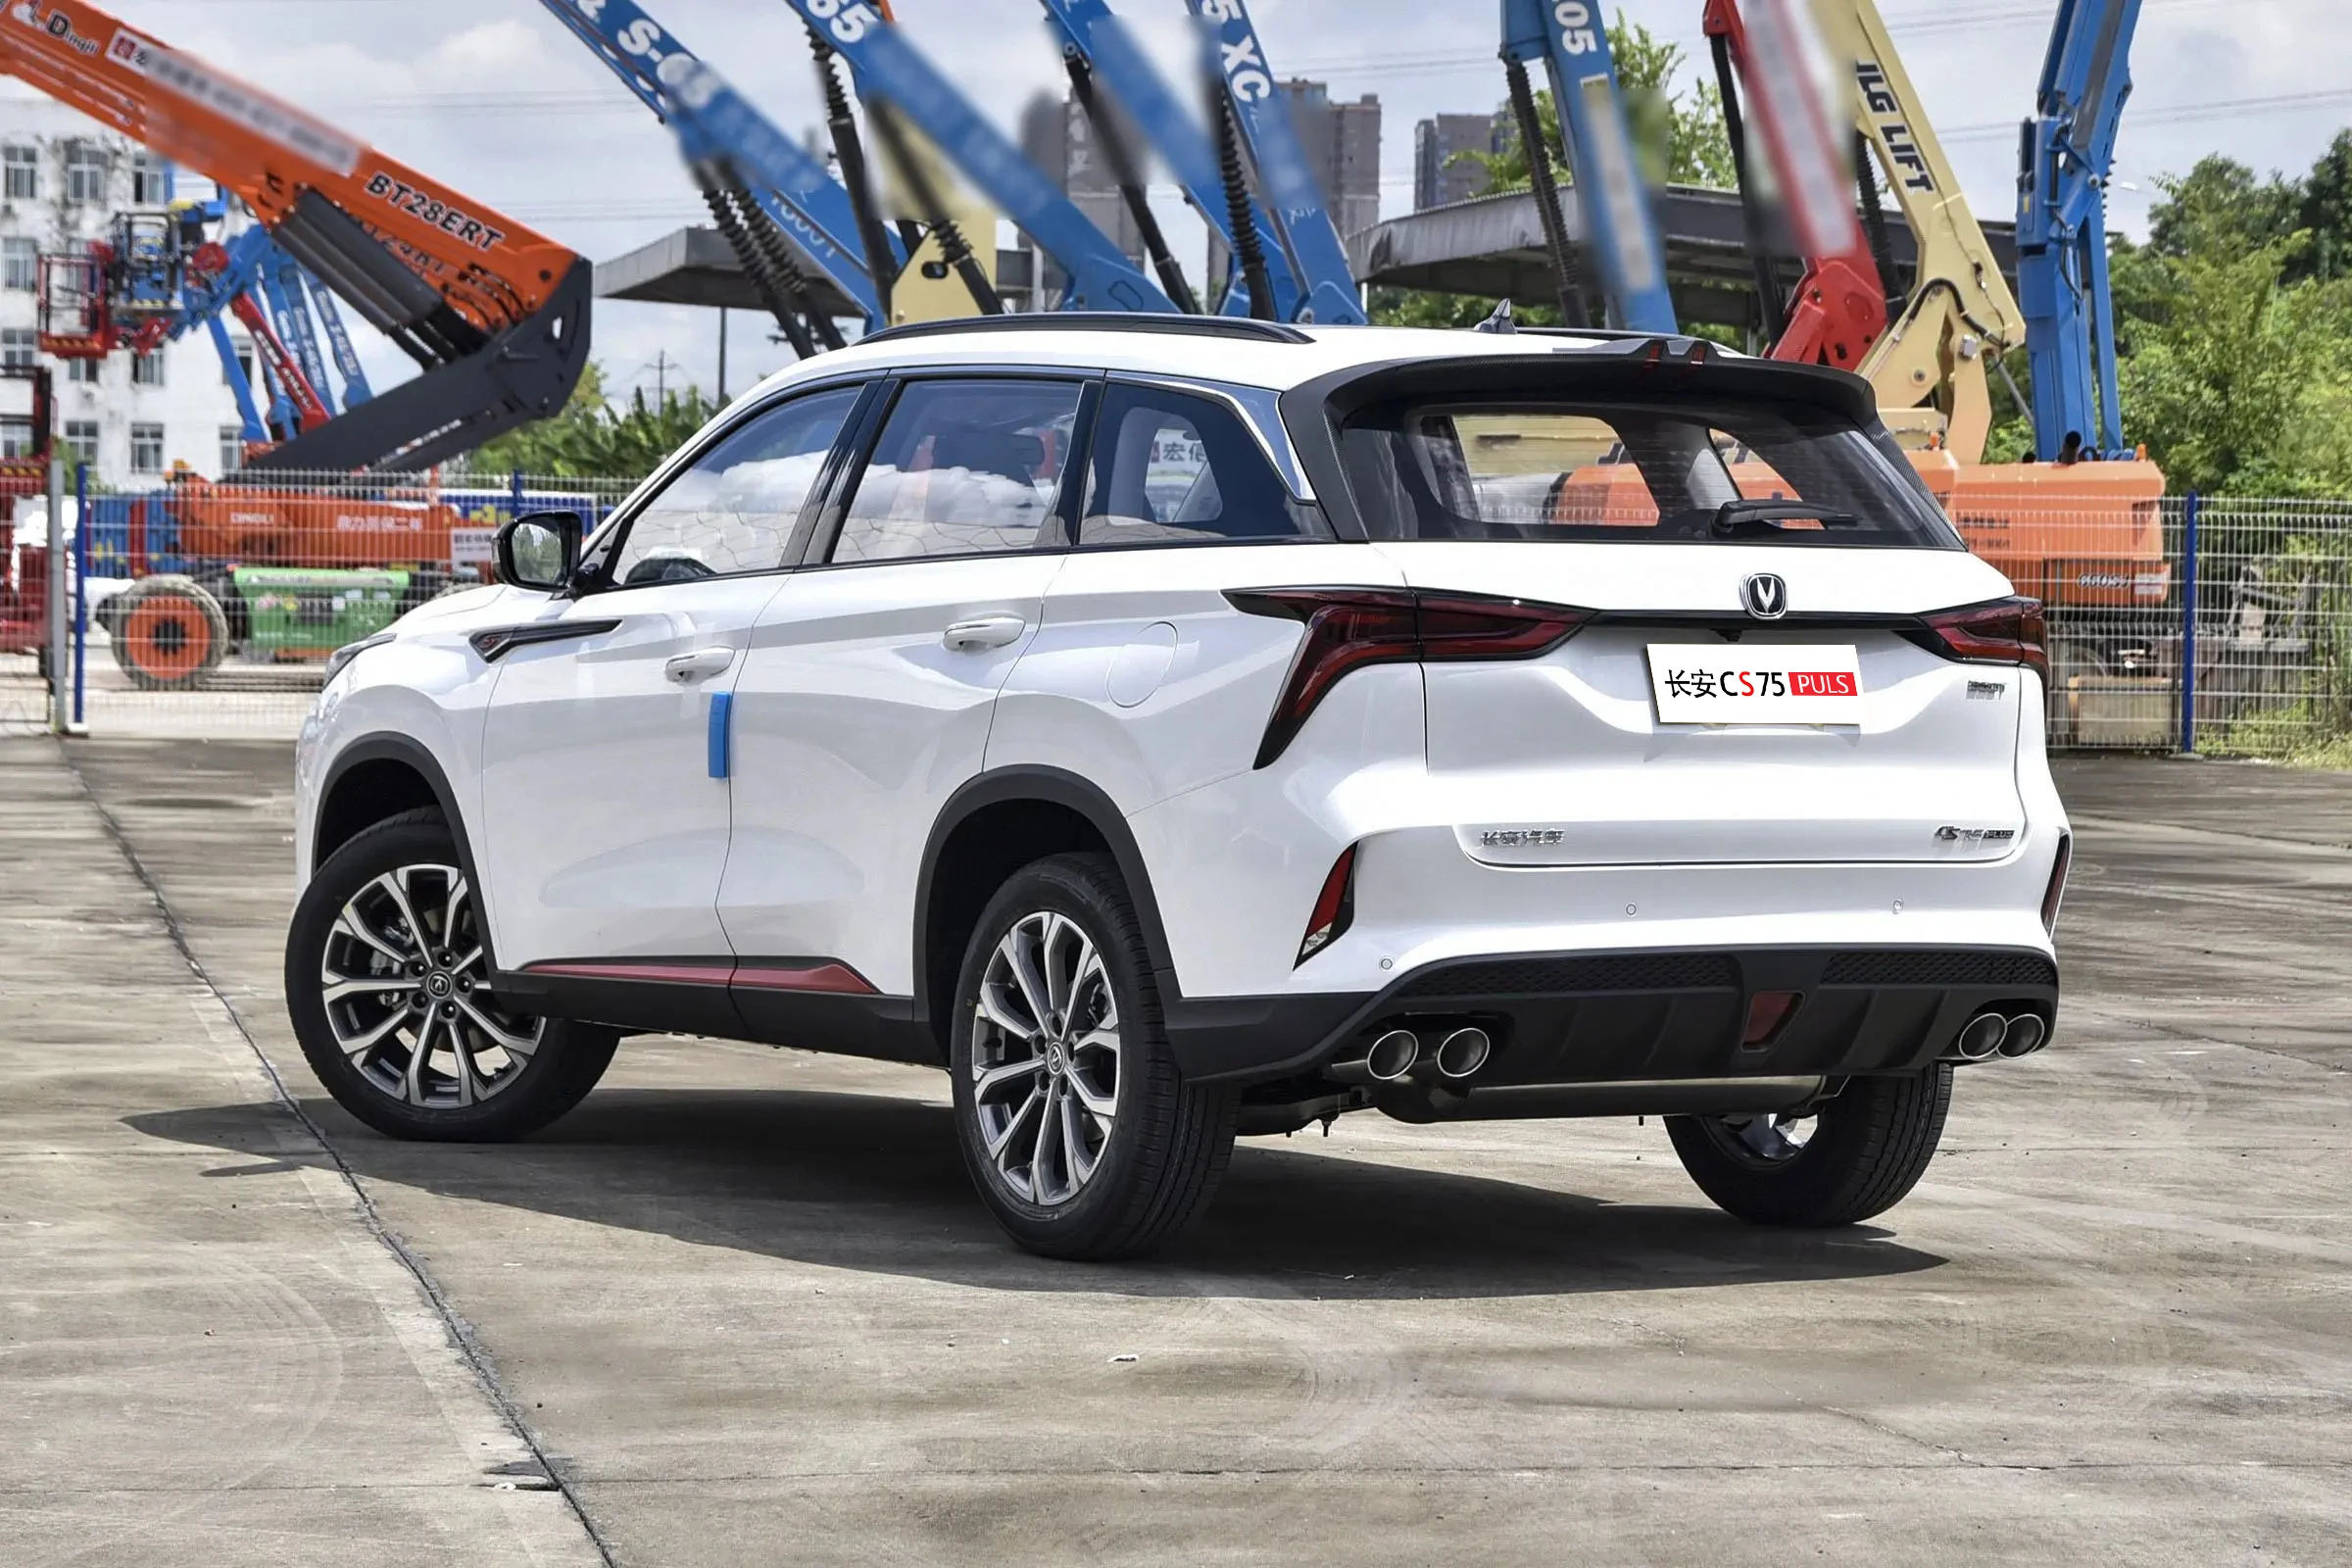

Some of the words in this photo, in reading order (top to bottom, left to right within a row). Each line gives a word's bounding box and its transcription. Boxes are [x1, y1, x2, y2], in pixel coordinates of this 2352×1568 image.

[1220, 34, 1271, 102] XC
[1880, 124, 1934, 192] LIFT
[365, 172, 505, 252] BT28ERT
[1796, 673, 1849, 694] PULS
